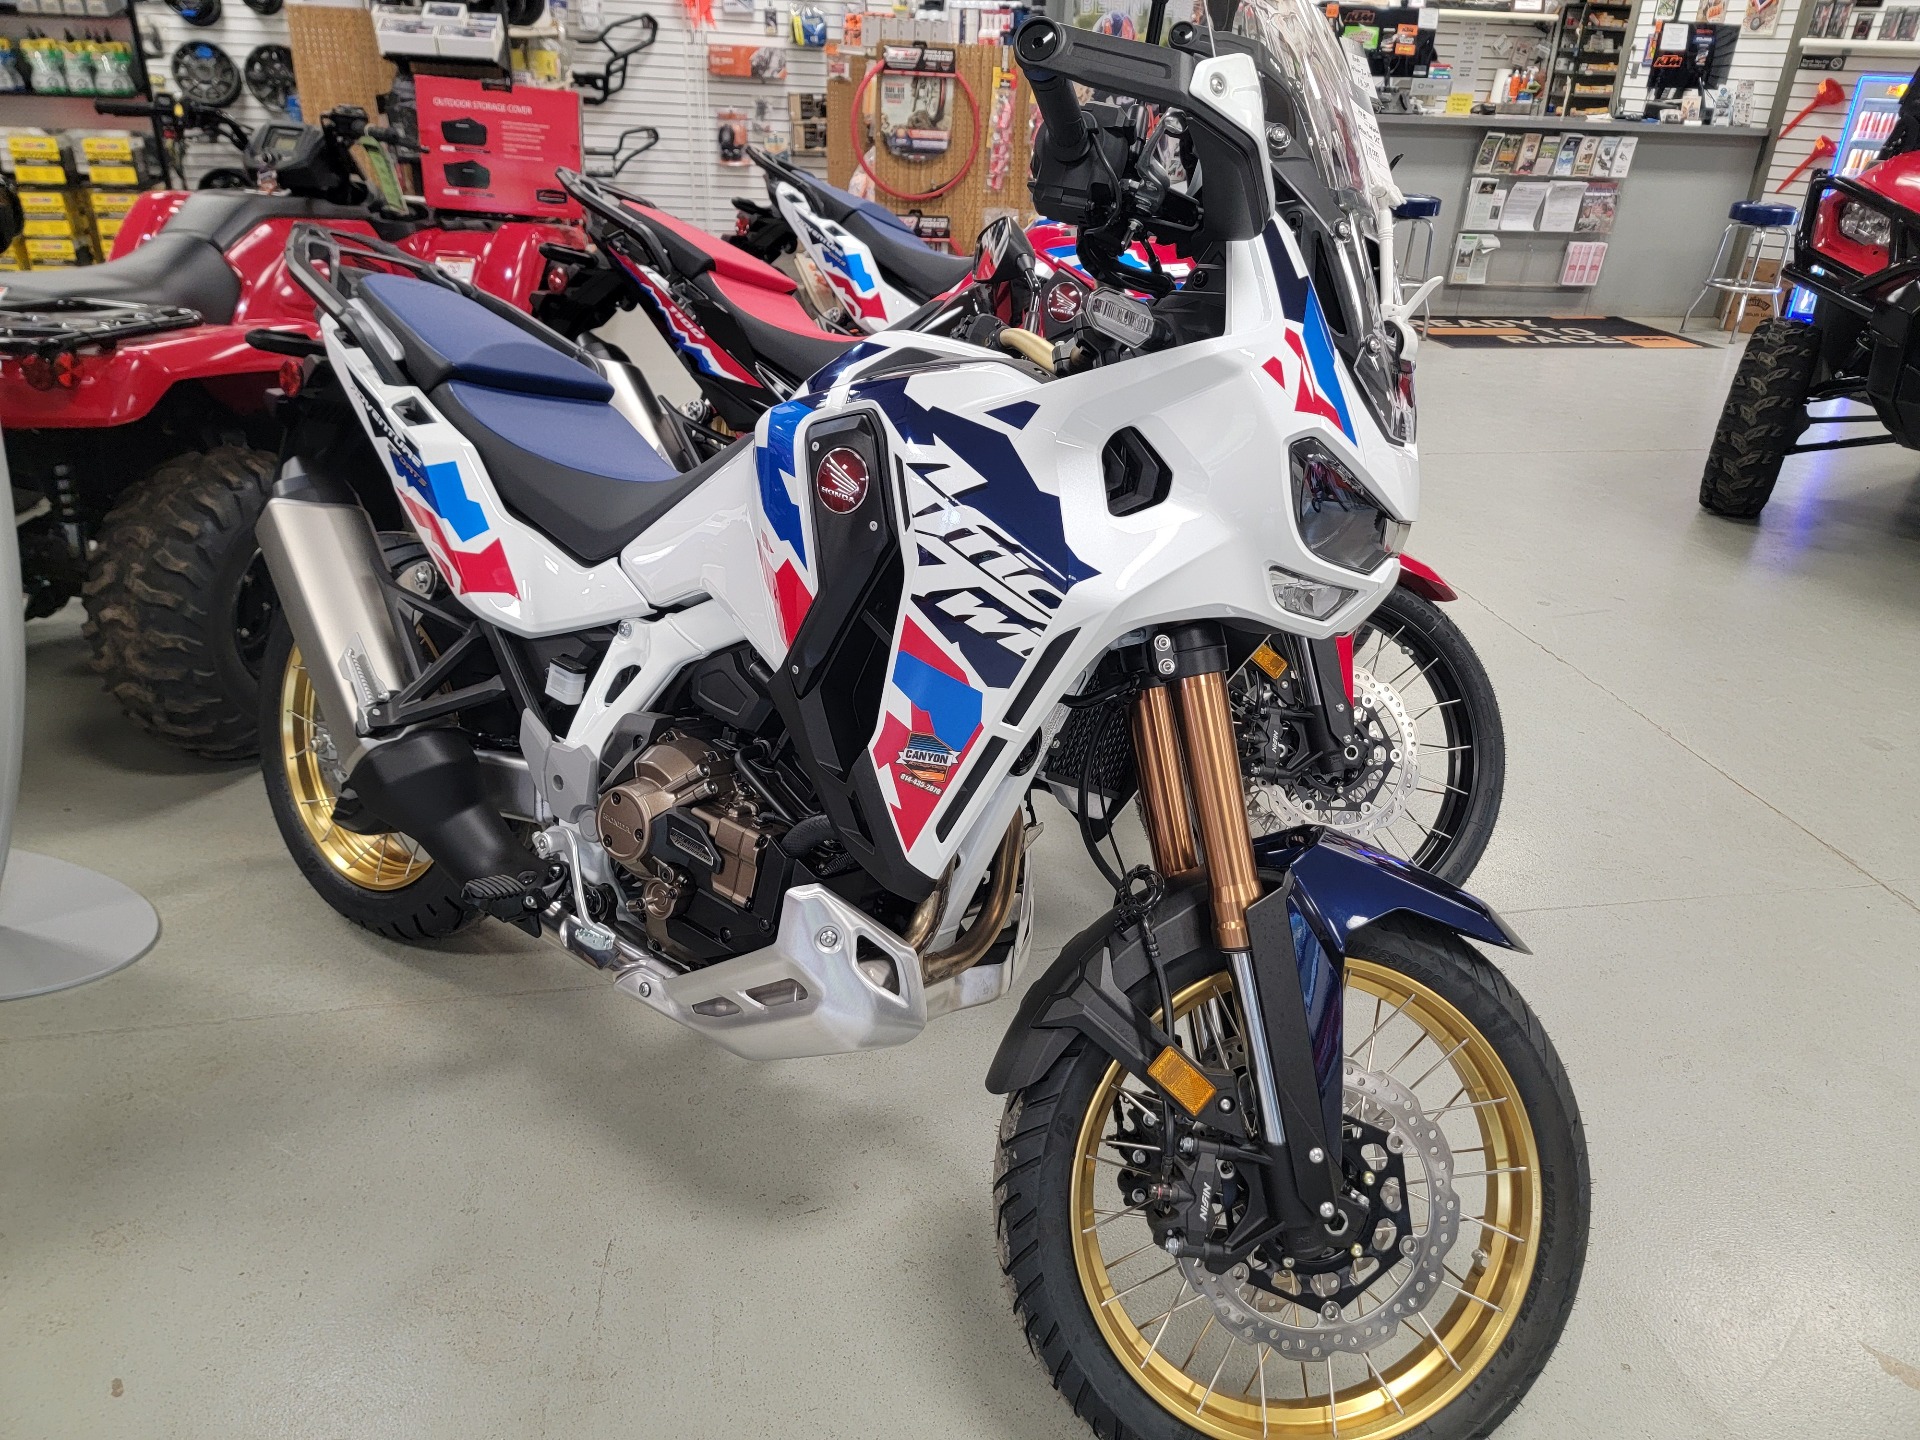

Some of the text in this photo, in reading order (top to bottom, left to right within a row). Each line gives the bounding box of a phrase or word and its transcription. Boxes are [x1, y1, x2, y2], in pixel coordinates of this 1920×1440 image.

[1653, 55, 1683, 68] KTM
[432, 97, 473, 109] OUTDOOR
[669, 305, 706, 340] 1100
[1529, 327, 1597, 336] TO
[1497, 335, 1625, 345] RACE
[350, 386, 424, 468] ADVENTURE
[821, 485, 856, 504] HONDA
[905, 749, 949, 765] CANYON
[1199, 1181, 1212, 1222] NISSIN
